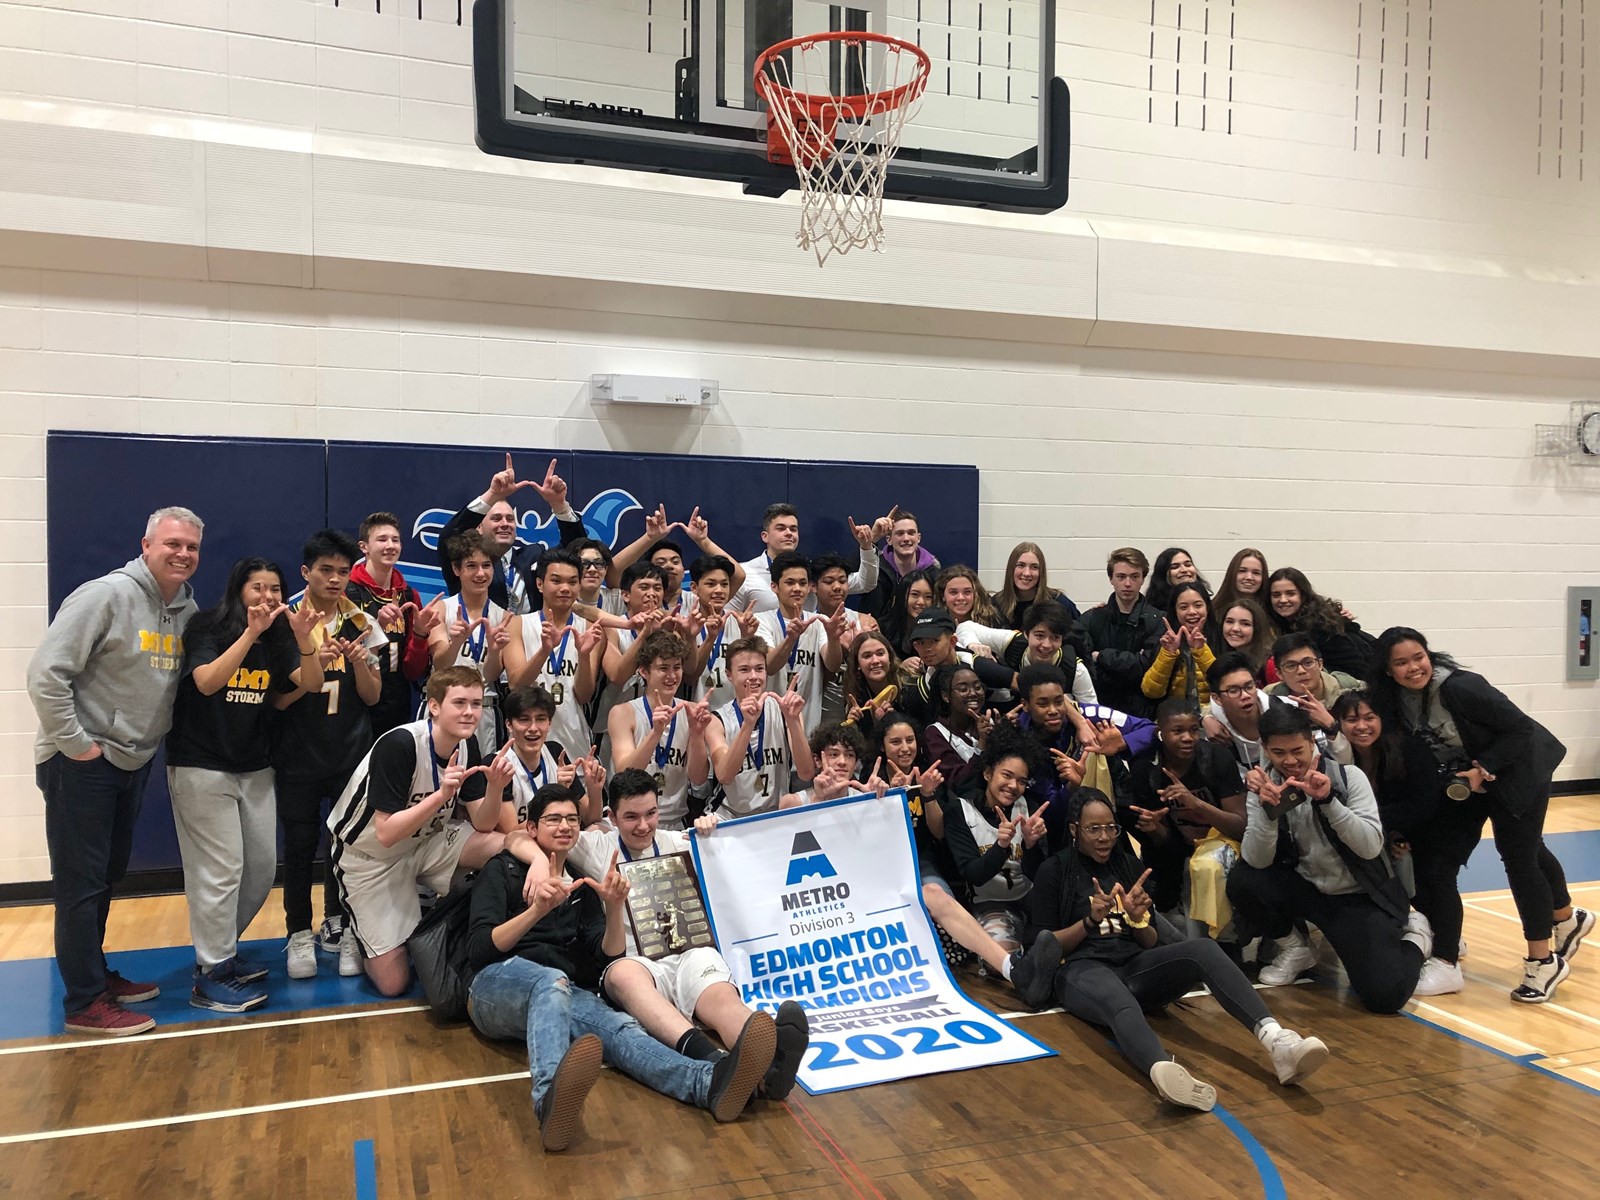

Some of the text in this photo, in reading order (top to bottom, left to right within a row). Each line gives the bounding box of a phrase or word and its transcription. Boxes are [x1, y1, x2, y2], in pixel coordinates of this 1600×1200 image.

[225, 690, 266, 704] STORM
[320, 680, 340, 715] 7
[781, 882, 850, 911] METRO
[792, 902, 846, 919] ATHLETICS
[789, 911, 856, 936] Division 3
[750, 922, 909, 978] EDMONTON
[742, 945, 930, 1004] HIGH SCHOOL
[756, 971, 931, 1016] CAMPIONS
[807, 1007, 961, 1036] ASKETBALL
[815, 1005, 901, 1023] Junior Boys
[806, 1020, 1003, 1072] 2020
